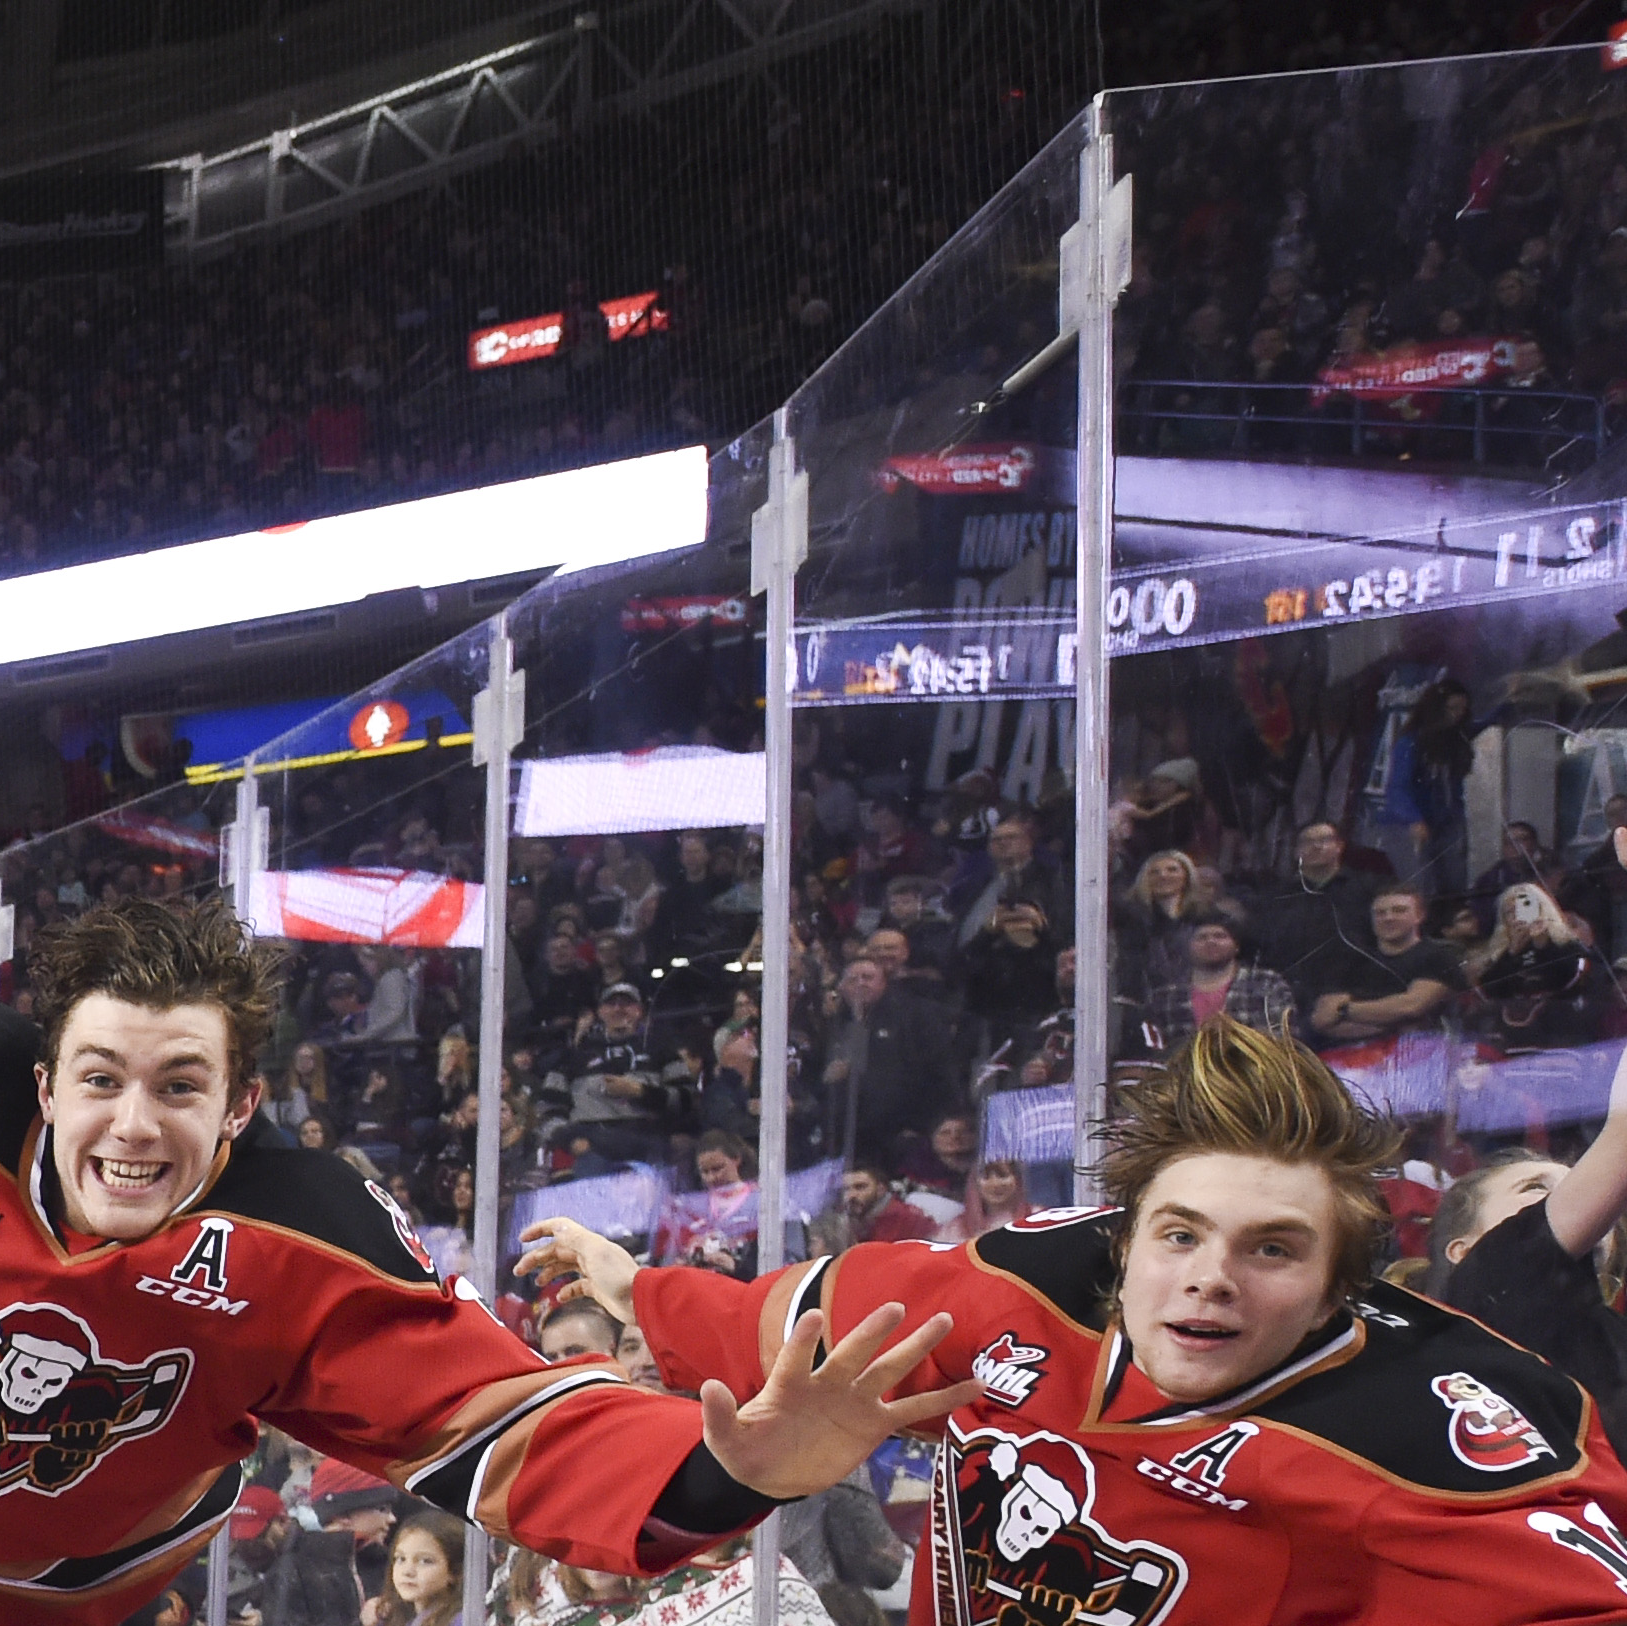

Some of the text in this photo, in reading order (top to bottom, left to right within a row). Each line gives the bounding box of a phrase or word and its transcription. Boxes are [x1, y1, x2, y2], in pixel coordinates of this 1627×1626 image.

[170, 1217, 235, 1293] A
[135, 1274, 250, 1316] CCM
[1134, 1455, 1249, 1512] CCM
[1171, 1420, 1260, 1486] A
